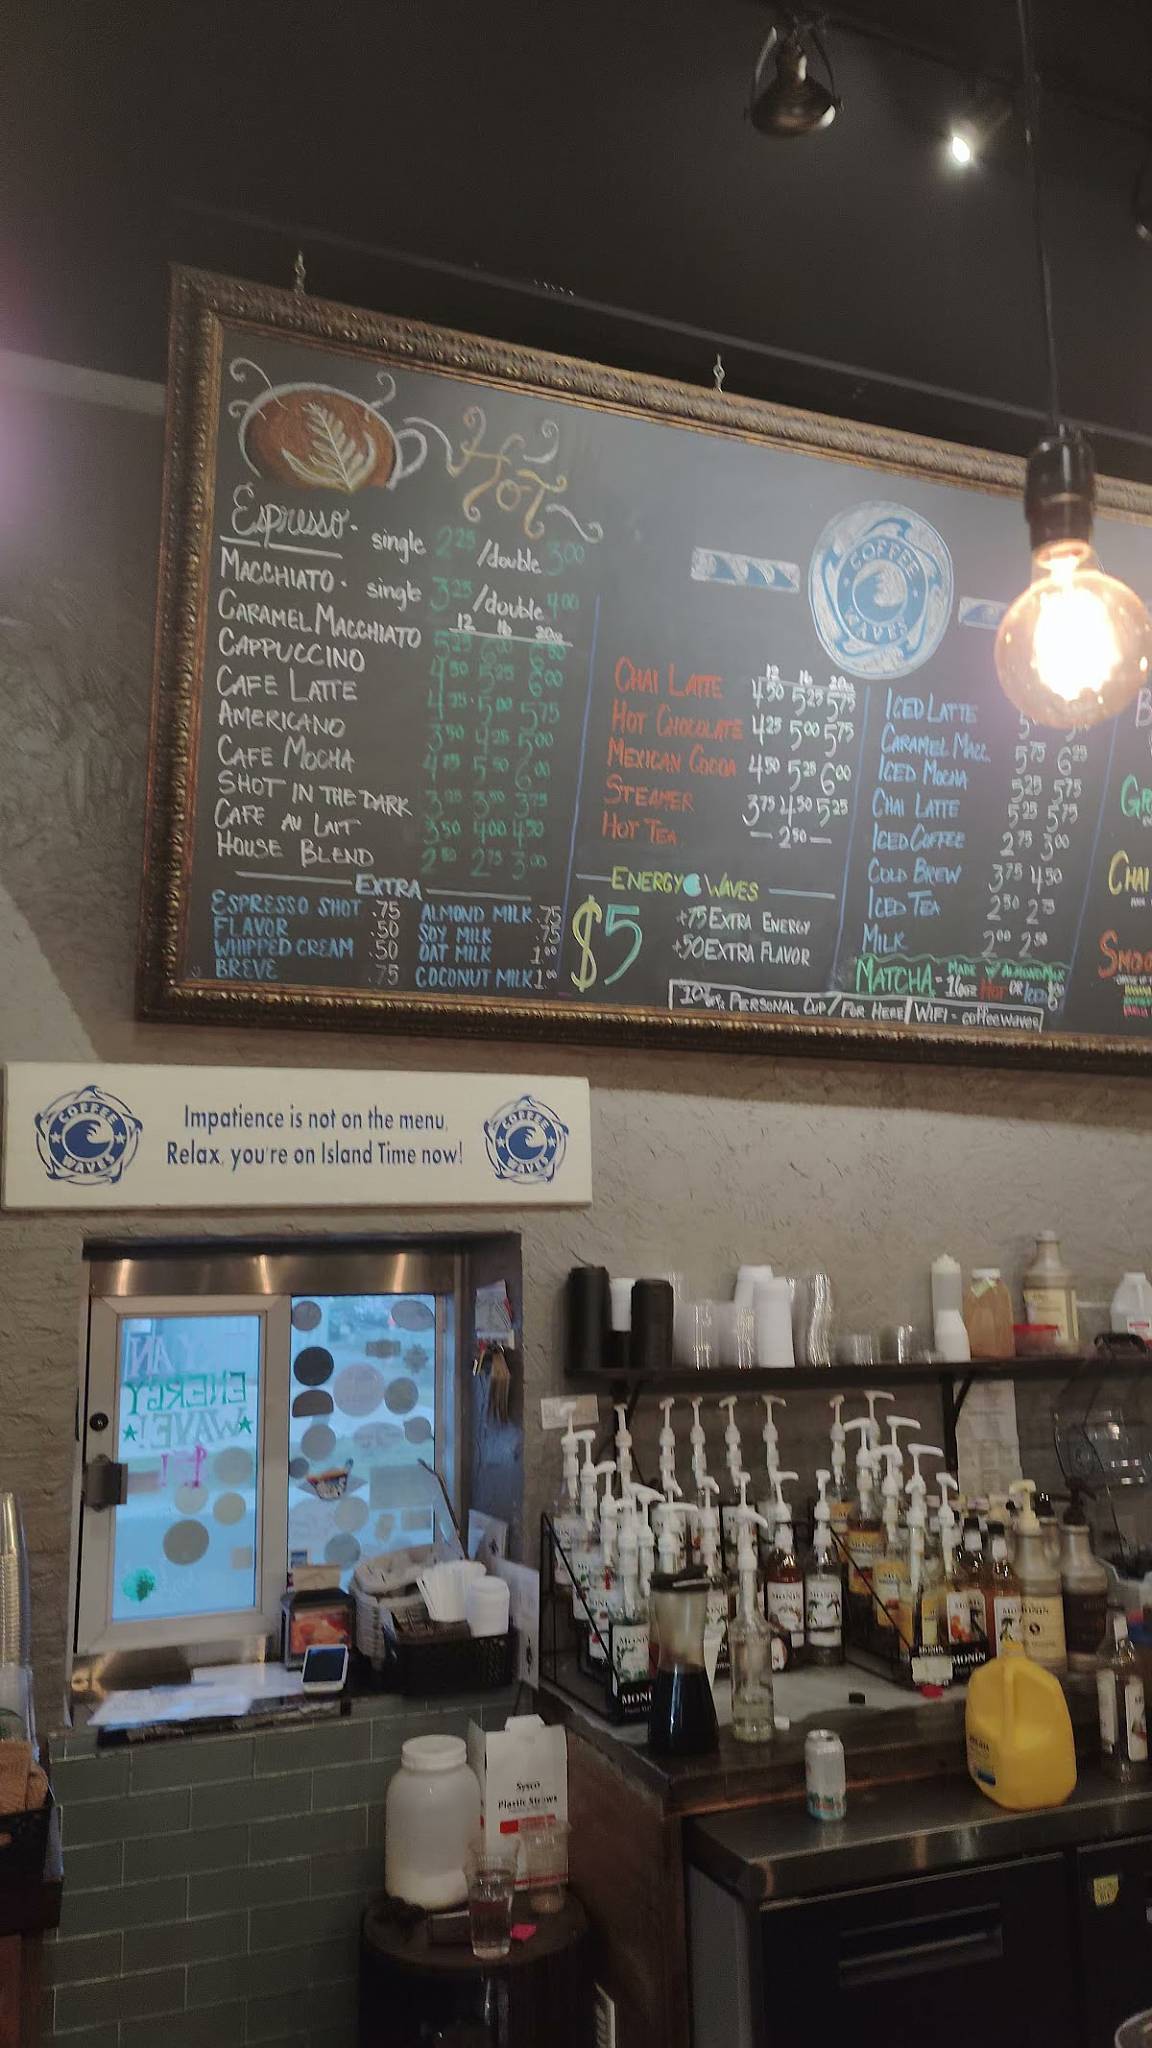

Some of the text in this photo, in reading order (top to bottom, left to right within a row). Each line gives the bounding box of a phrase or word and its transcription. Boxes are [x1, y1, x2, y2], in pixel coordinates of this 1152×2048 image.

[371, 528, 427, 564] single
[366, 577, 423, 612] single
[217, 587, 422, 648] CARAMEL MACCHIATO
[218, 626, 366, 672] CAPPUCCINO
[216, 664, 358, 702] CAFE LATTE
[614, 655, 659, 695] CHAI
[668, 663, 724, 699] LATTE
[218, 699, 346, 738] AMERICANO
[612, 699, 647, 735] HOT
[656, 703, 744, 743] CHOCOLATE
[886, 687, 977, 724] ICED LATTE
[217, 734, 356, 773] CAFE MOCHA
[607, 736, 681, 775] MEXICAN
[881, 721, 949, 757] CARAMEL
[878, 753, 917, 782] ICED
[923, 758, 968, 791] MOCHA
[217, 769, 287, 798] SHOT
[291, 781, 314, 805] IN
[319, 785, 357, 807] THE
[358, 789, 413, 818] DARK
[604, 773, 695, 814] STEAMER
[872, 786, 905, 818] CHAI
[915, 791, 960, 819] LATTE
[214, 797, 265, 830] CAFE
[602, 810, 640, 841] HOT
[643, 817, 677, 846] TEA
[217, 829, 375, 868] HOUSE BLEND
[872, 821, 909, 853] ICED
[910, 822, 966, 852] COFFEE
[355, 873, 422, 901] EXTRA
[611, 866, 760, 902] ENERGY WAVES
[868, 856, 908, 884] COLD
[913, 856, 962, 887] BREW
[211, 888, 309, 916] ESPRESSO
[317, 896, 363, 918] SHOT
[421, 902, 485, 924] ALMOND
[492, 904, 533, 924] MILK
[868, 885, 907, 919] ICED
[907, 889, 941, 917] TEA
[213, 915, 289, 938] FLAVOR
[418, 922, 448, 945] SOY
[456, 926, 492, 945] MILK
[708, 906, 752, 931] EXTRA
[762, 912, 811, 936] ENERGY
[213, 938, 292, 958] WHIPPED
[296, 937, 354, 960] CREAM
[419, 943, 449, 963] OAT
[455, 944, 491, 964] MILK
[570, 894, 643, 994] $5
[705, 938, 755, 963] EXTRA
[760, 940, 811, 967] FLAVOR
[862, 922, 908, 954] MILK
[215, 957, 279, 980] BREVE
[415, 965, 491, 989] COCONUT
[495, 967, 533, 989] MILK
[57, 1102, 119, 1125] COFFEE
[184, 1103, 285, 1136] Impatience
[290, 1104, 303, 1129] is
[308, 1108, 337, 1130] not
[342, 1112, 363, 1130] on
[368, 1105, 394, 1130] the
[62, 1153, 116, 1175] WAVES
[231, 1146, 288, 1172] you're
[294, 1147, 315, 1165] on
[321, 1140, 373, 1166] Island
[377, 1140, 417, 1165] Time
[422, 1141, 463, 1165] now!
